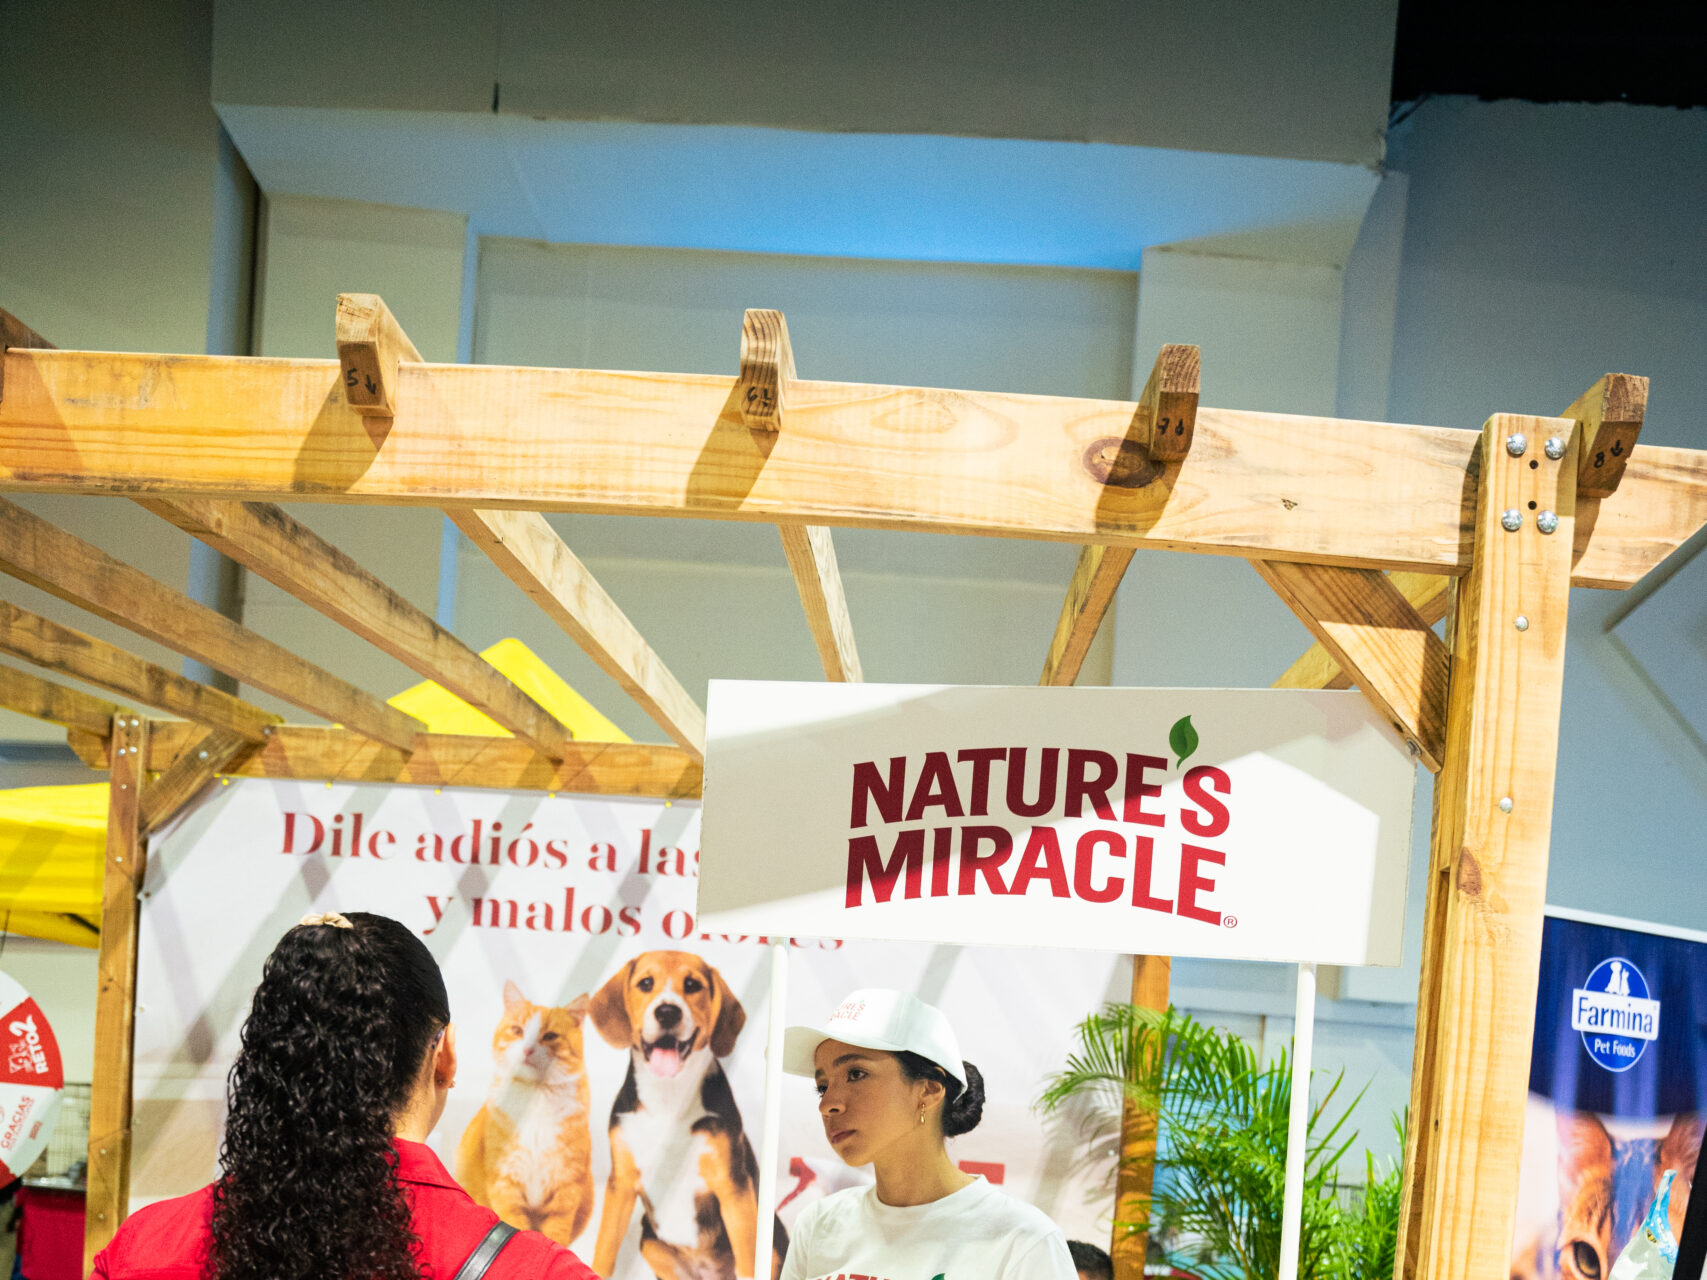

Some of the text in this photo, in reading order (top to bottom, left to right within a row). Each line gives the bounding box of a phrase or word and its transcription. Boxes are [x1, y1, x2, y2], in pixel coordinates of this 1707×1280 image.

[346, 367, 359, 387] 5
[1594, 451, 1605, 468] 8
[850, 715, 1231, 838] NATURE'S
[281, 812, 397, 860] Dile
[415, 819, 568, 870] adiós
[587, 842, 621, 874] a
[422, 895, 454, 936] y
[471, 886, 641, 938] malos
[1577, 996, 1653, 1034] Farmina
[9, 1013, 49, 1074] RETO 2
[1594, 1038, 1636, 1058] Pet Foods
[0, 1095, 32, 1150] GRACIAS
